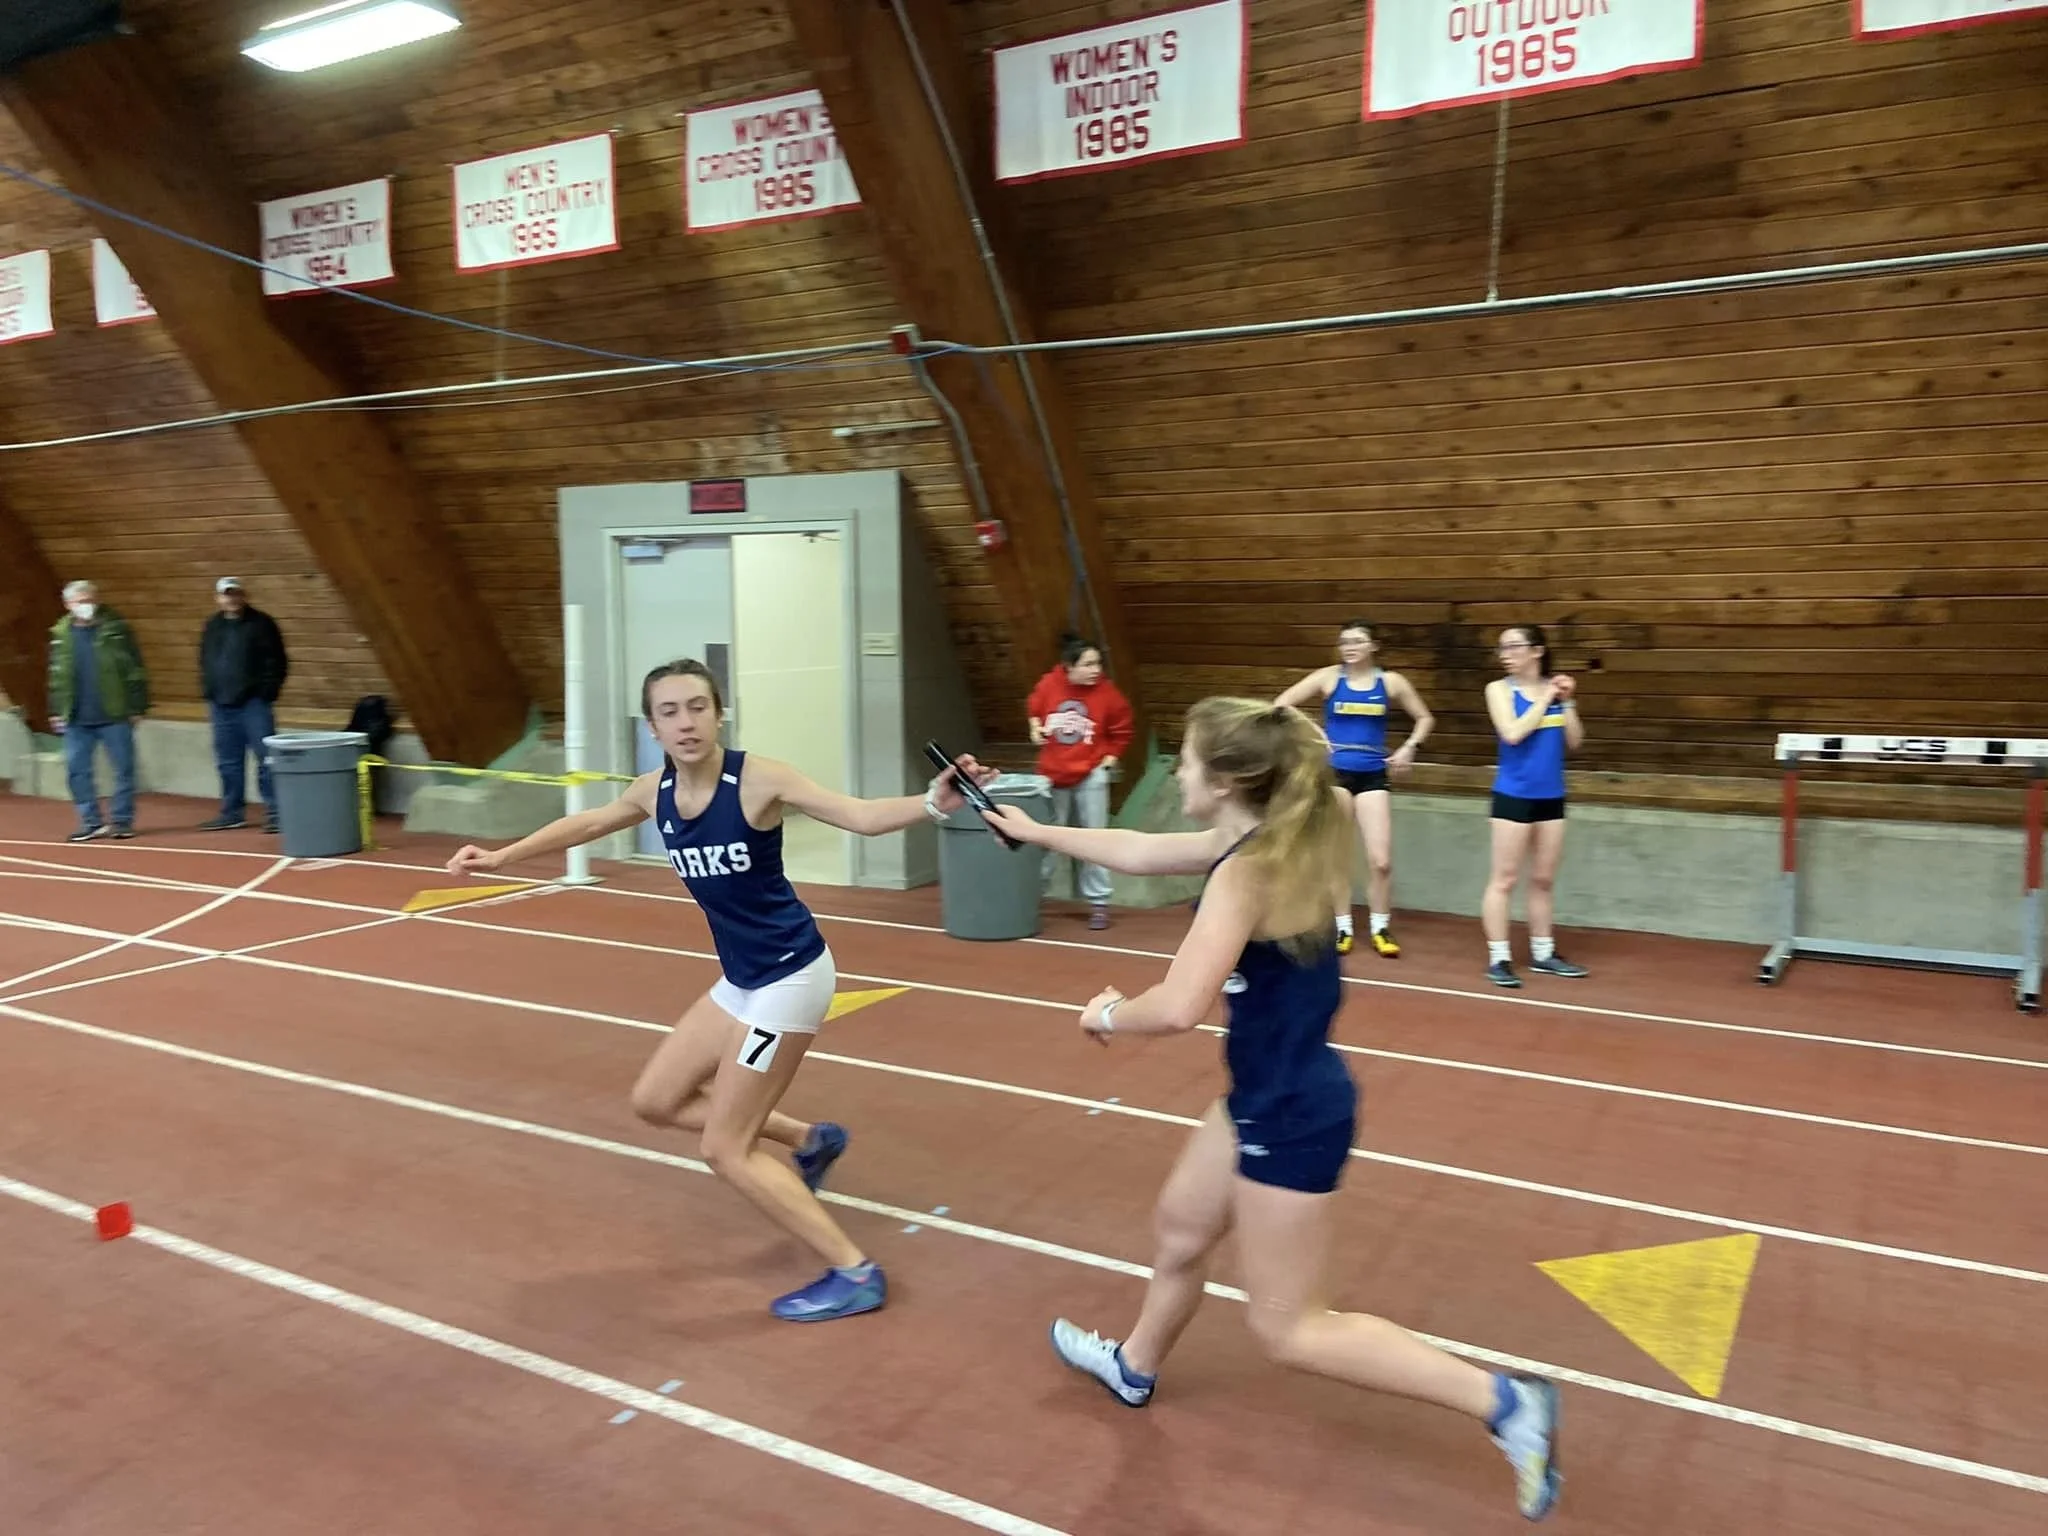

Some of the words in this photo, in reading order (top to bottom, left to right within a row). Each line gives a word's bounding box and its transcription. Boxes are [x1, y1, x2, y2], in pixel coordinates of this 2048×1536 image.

[1050, 30, 1178, 84] WOMEN'S
[1477, 27, 1577, 86] 1985
[1065, 70, 1160, 118] INDOOR
[1074, 109, 1150, 160] 1985
[505, 159, 559, 193] MEN'S
[697, 146, 762, 184] CROSS
[464, 196, 514, 229] CROSS
[524, 178, 607, 217] COUNTRY
[754, 170, 815, 212] 1985
[1876, 739, 1947, 752] UCS
[745, 1027, 777, 1066] 7
